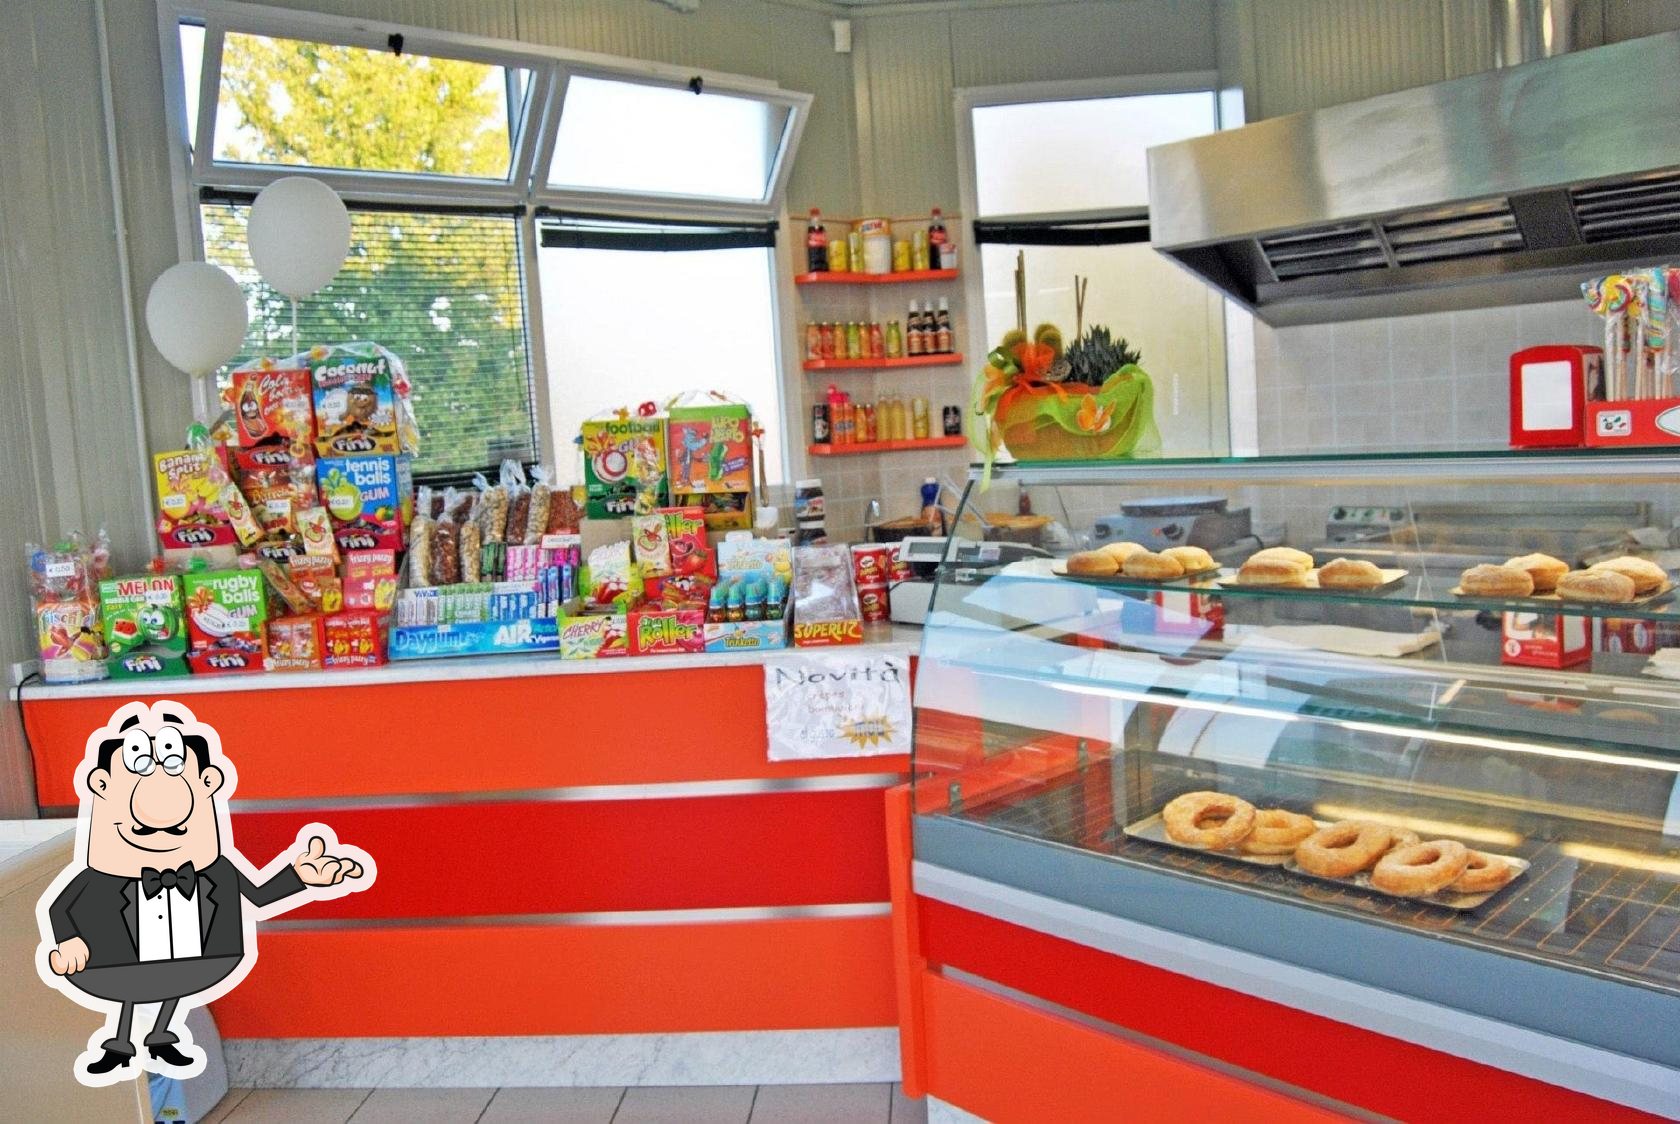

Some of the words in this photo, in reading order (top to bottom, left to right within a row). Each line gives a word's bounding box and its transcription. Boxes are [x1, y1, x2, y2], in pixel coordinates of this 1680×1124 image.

[315, 359, 386, 382] Coconut
[346, 458, 390, 472] tennis
[354, 469, 391, 486] balls
[360, 487, 390, 502] GUM
[213, 574, 258, 592] rugby
[221, 589, 260, 605] balls
[494, 618, 532, 645] AIR
[563, 618, 607, 641] CHERRY
[639, 616, 699, 651] Roller
[776, 661, 901, 686] Novità
